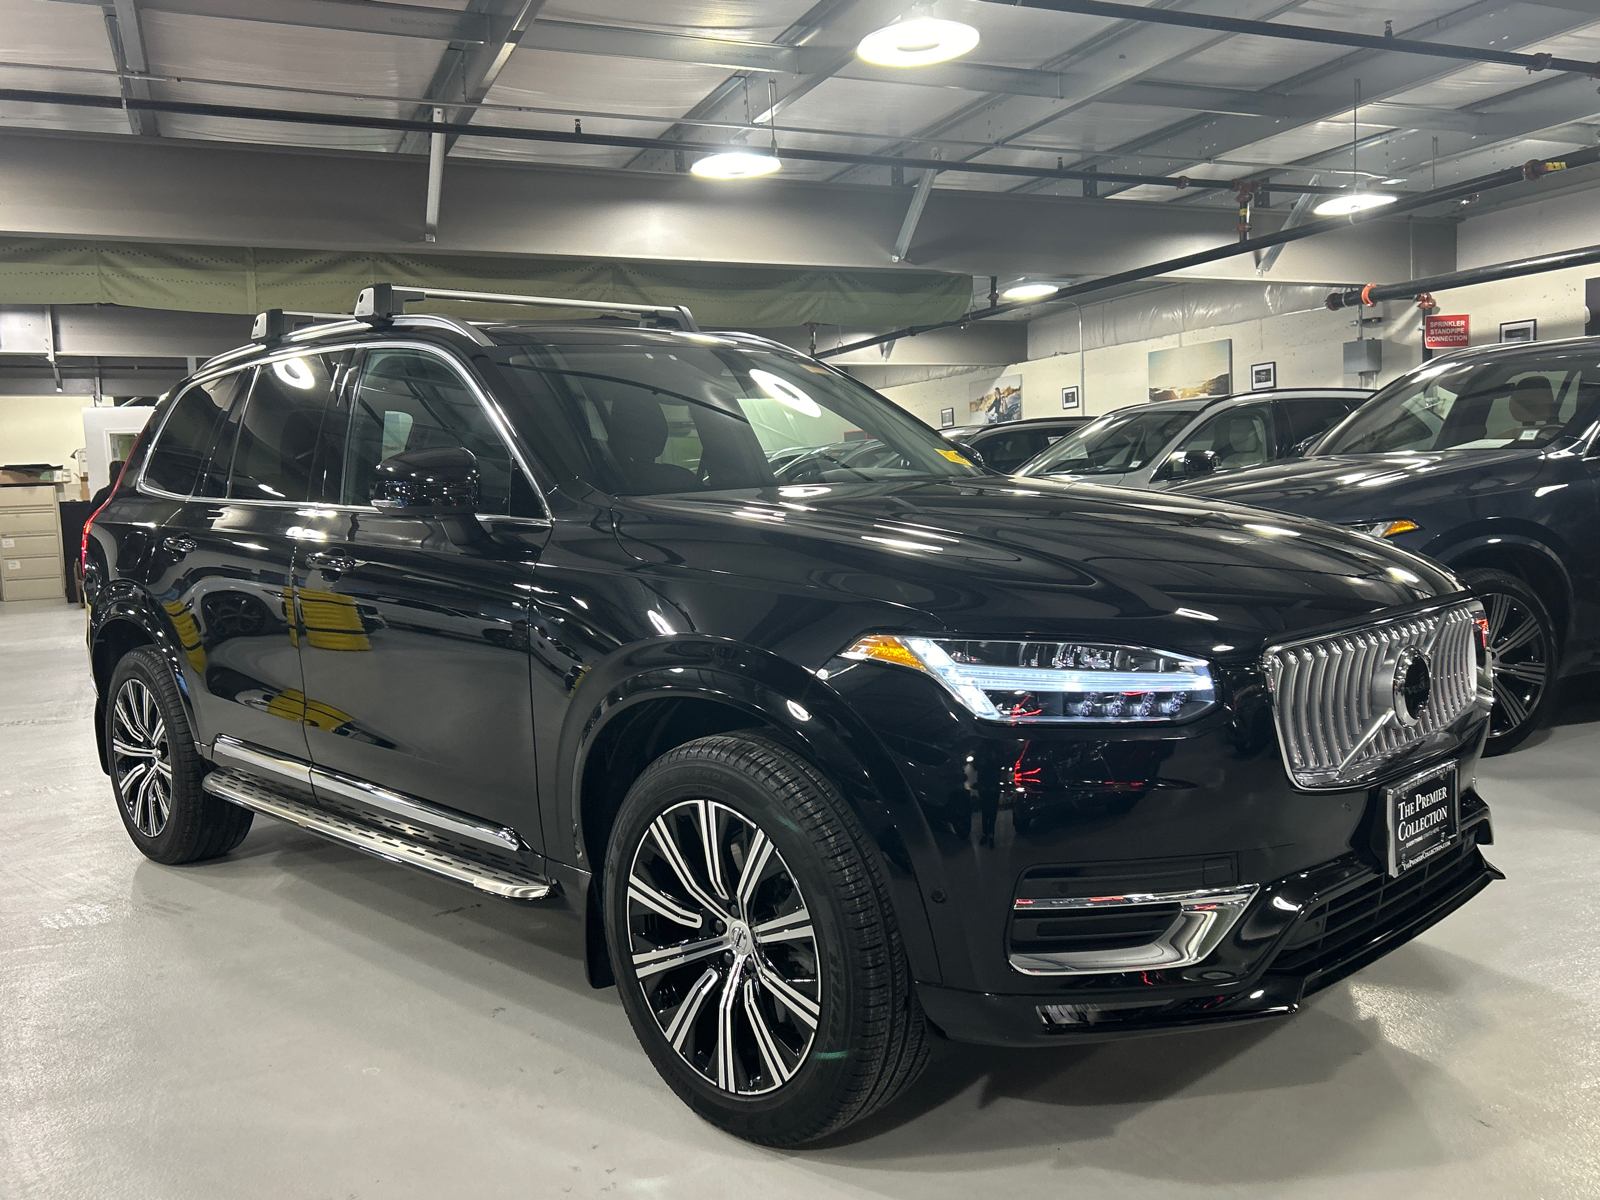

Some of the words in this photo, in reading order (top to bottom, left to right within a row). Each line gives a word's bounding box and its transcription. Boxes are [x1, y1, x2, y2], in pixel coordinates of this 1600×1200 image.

[1398, 801, 1415, 821] THE
[1415, 786, 1448, 813] PREMIER
[1398, 805, 1448, 841] COLLECTION
